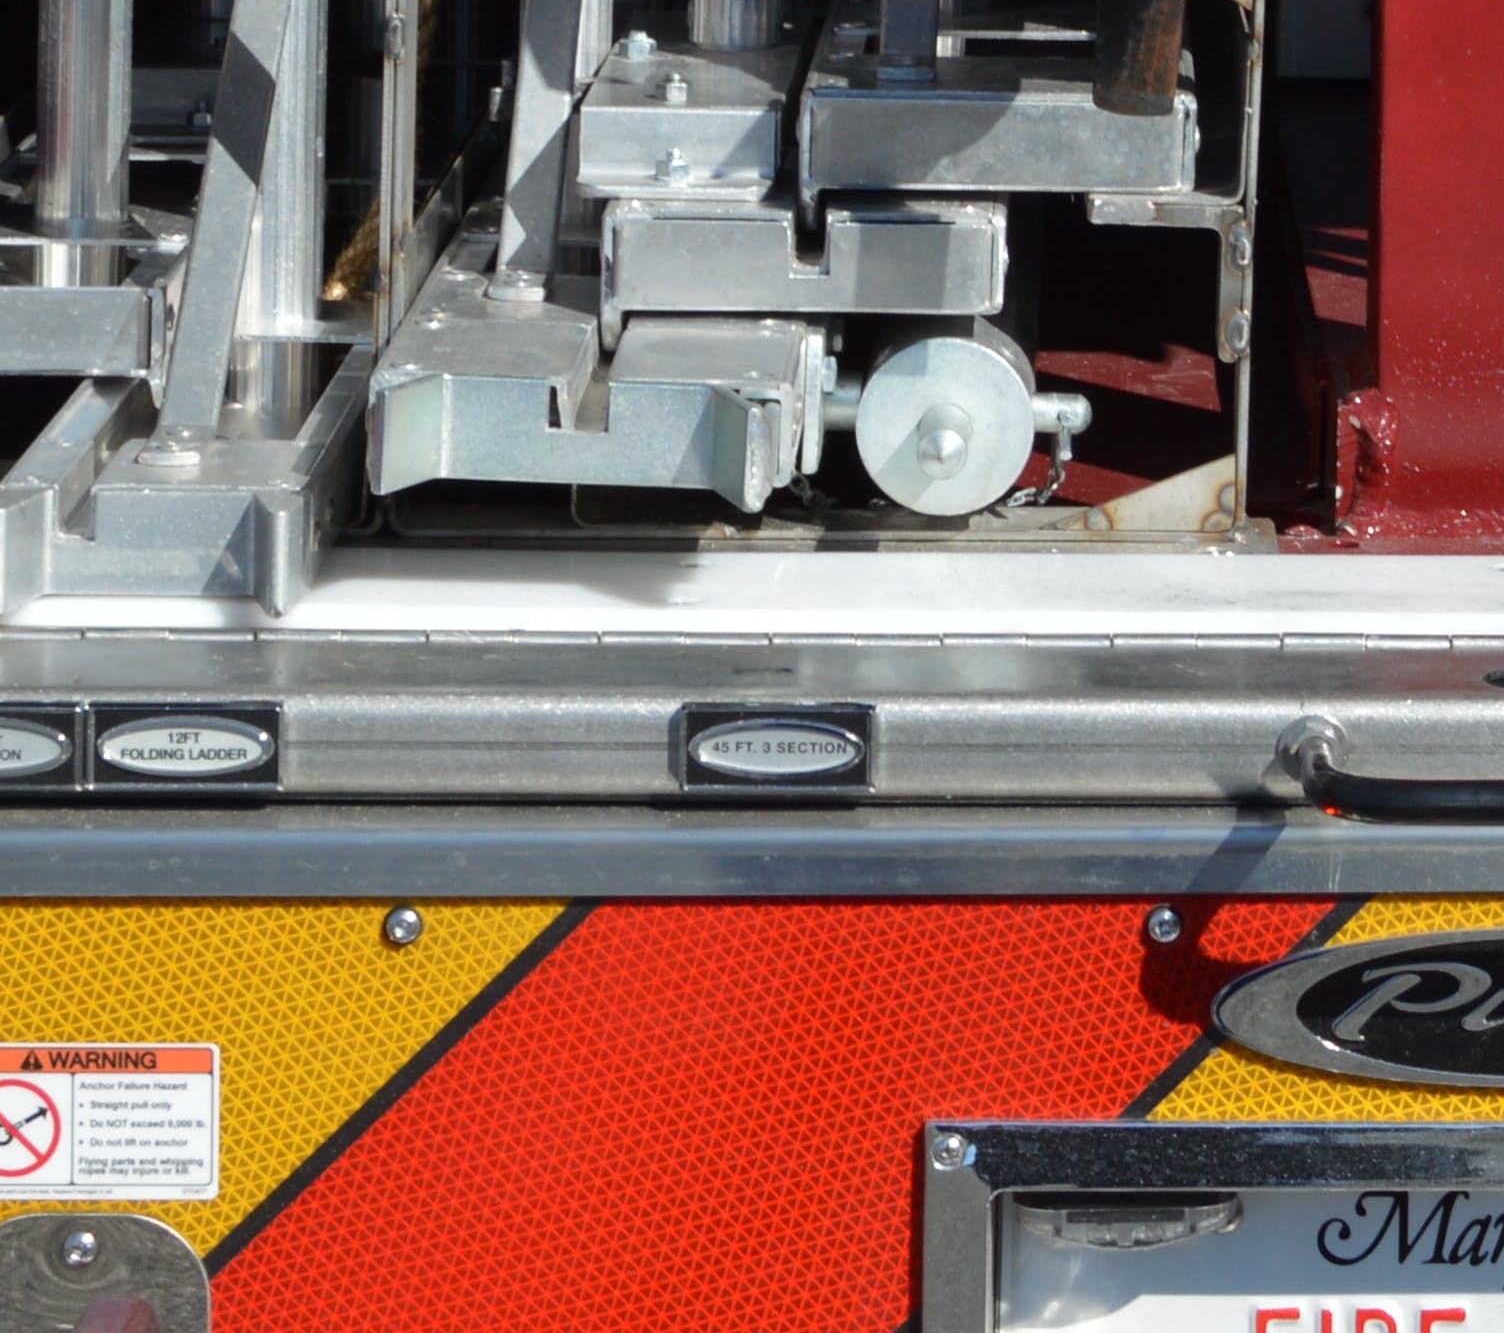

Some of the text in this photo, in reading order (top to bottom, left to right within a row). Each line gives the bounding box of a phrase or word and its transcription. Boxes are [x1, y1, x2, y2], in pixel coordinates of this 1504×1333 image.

[168, 732, 200, 744] 12FT
[712, 742, 848, 754] 45 FT. 3 SECTION
[120, 748, 248, 761] FOLDING LADDER
[48, 1051, 157, 1070] WARNING
[79, 1082, 187, 1090] Anchor Failure Hazard
[90, 1100, 172, 1110] Straight pull only
[90, 1119, 103, 1128] Do
[106, 1119, 127, 1128] NOT
[130, 1119, 165, 1128] exceed
[90, 1138, 103, 1146] Do
[106, 1138, 122, 1146] not
[154, 1138, 188, 1146] anchor
[79, 1157, 204, 1167] Flying parts and whipping
